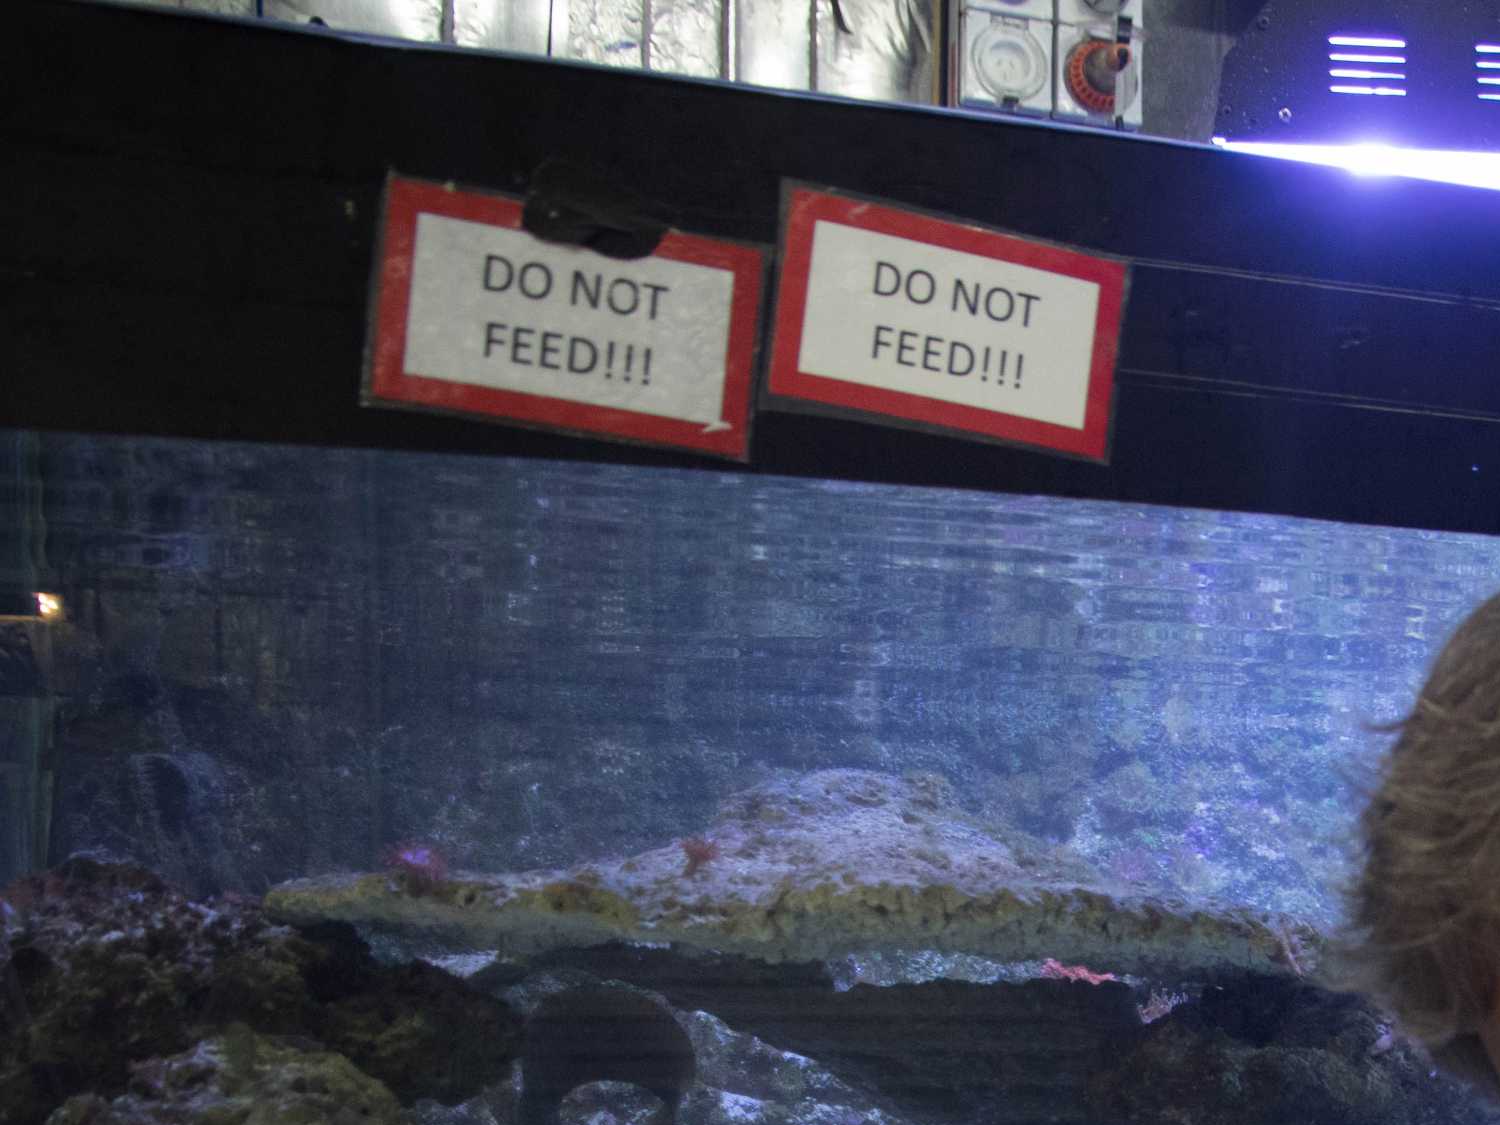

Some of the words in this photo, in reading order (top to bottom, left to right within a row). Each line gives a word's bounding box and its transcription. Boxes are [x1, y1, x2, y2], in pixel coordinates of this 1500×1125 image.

[481, 253, 554, 302] DO
[570, 269, 670, 321] NOT
[872, 259, 936, 305] DO
[951, 278, 1041, 328] NOT
[482, 321, 653, 386] FEED!!!
[871, 324, 1025, 390] FEED!!!
